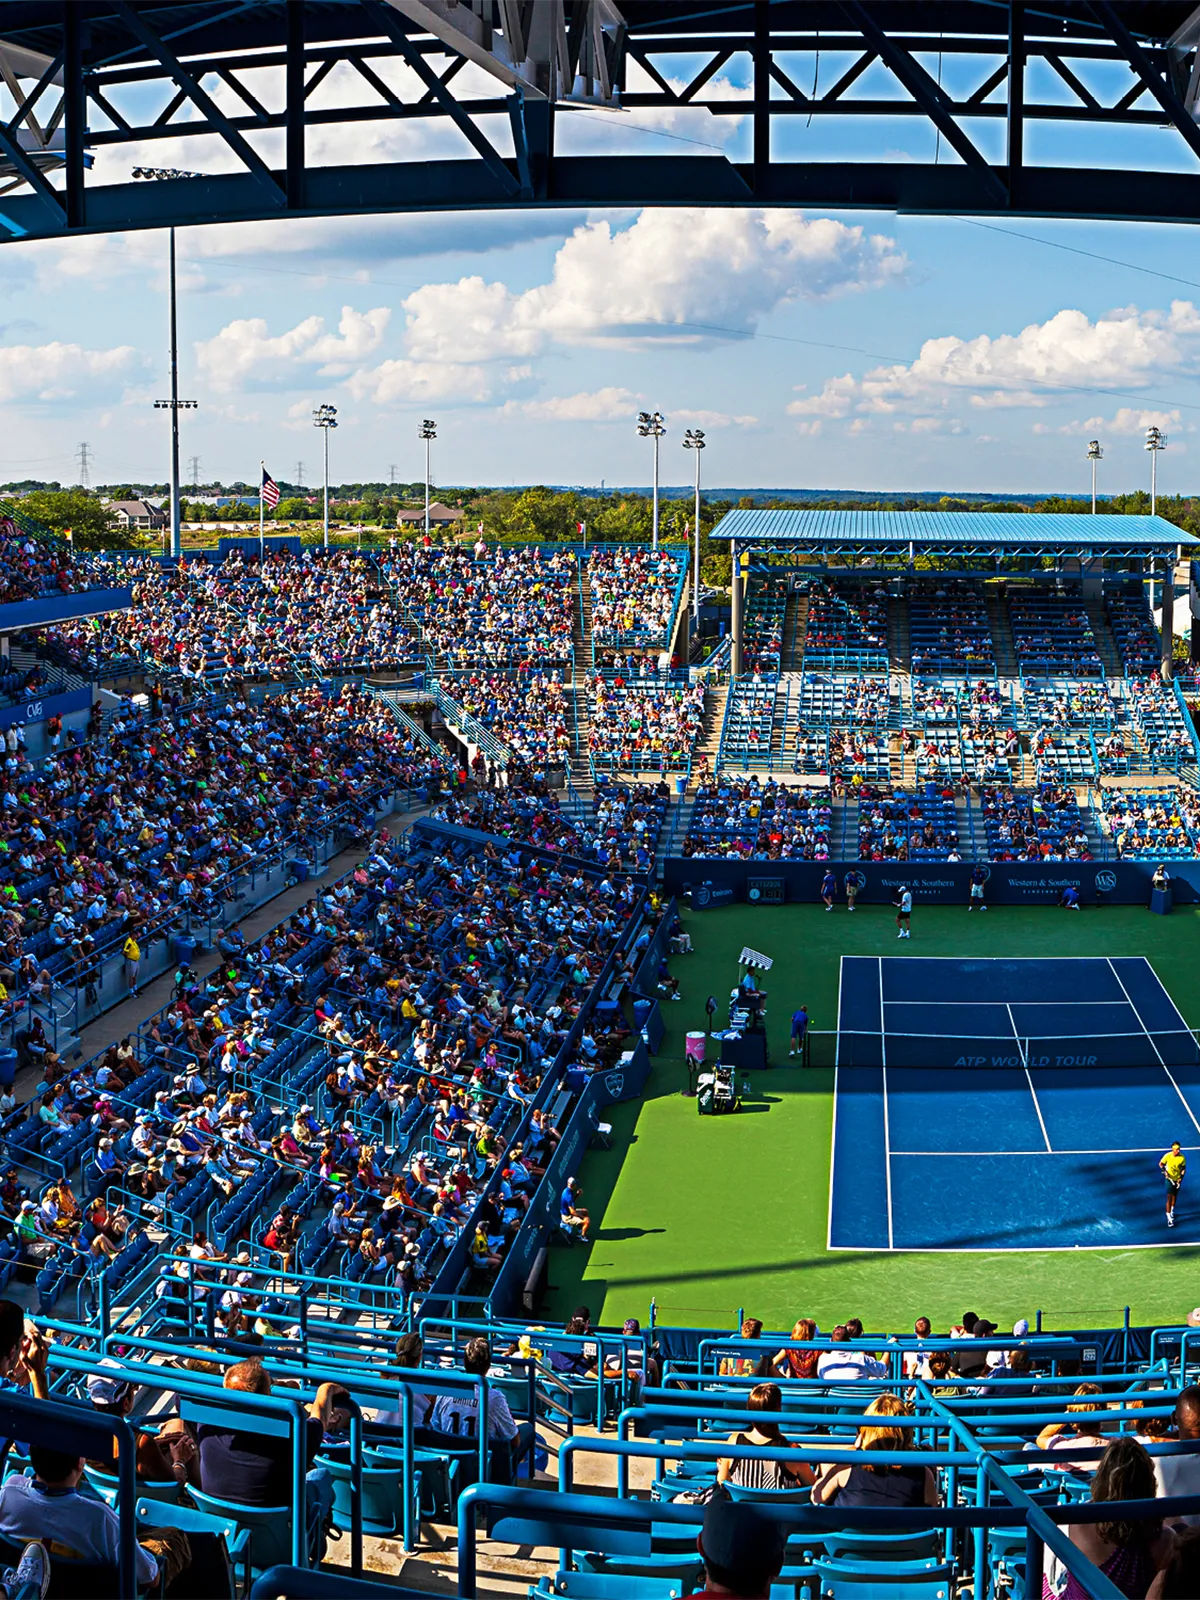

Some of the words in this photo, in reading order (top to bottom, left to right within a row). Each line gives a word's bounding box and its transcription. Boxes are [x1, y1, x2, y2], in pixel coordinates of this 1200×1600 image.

[881, 879, 911, 887] Western
[912, 879, 921, 887] &
[922, 879, 955, 887] Southern
[954, 1056, 987, 1067] ATP
[1056, 1055, 1098, 1066] TOUR
[449, 1411, 477, 1437] 11
